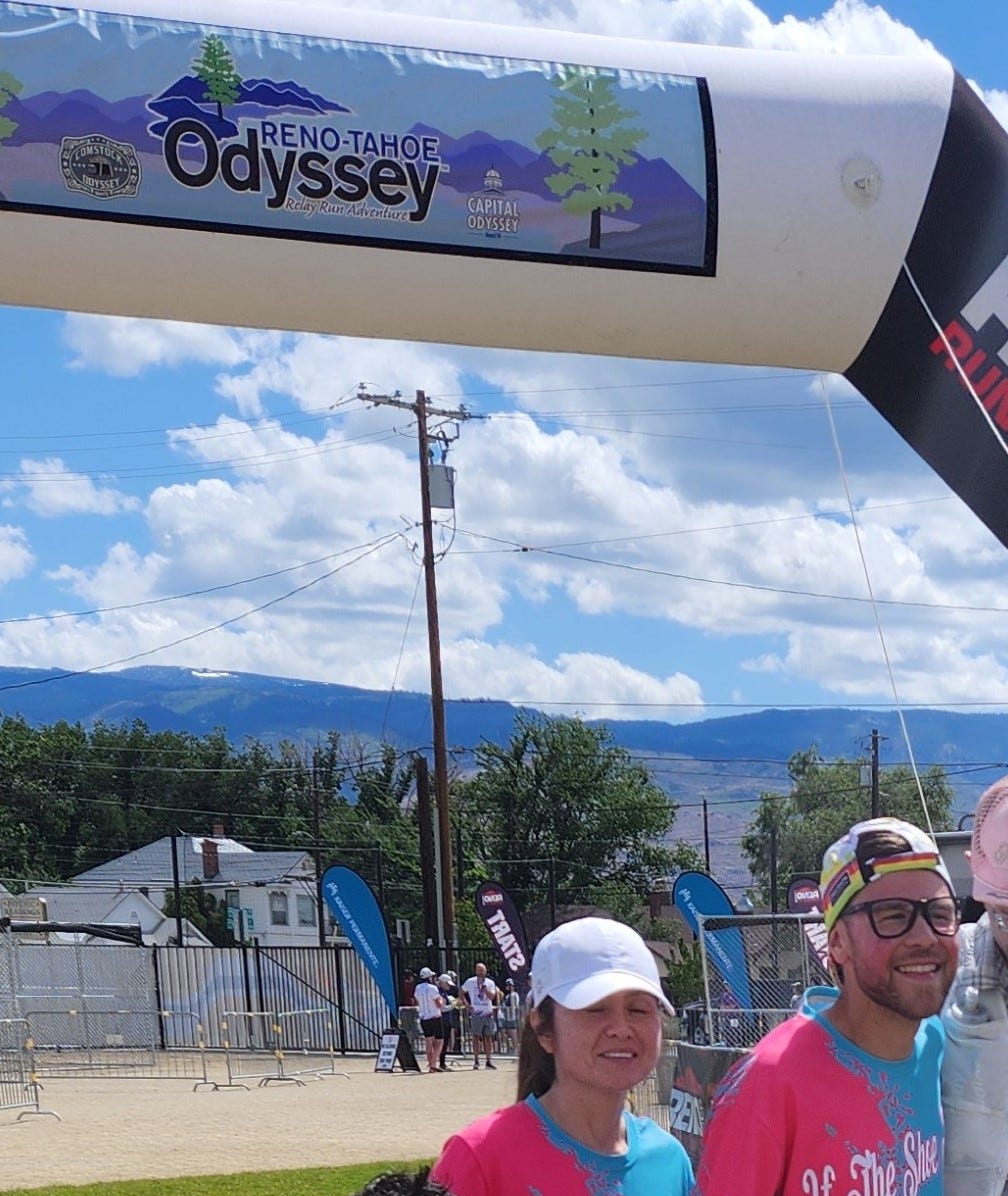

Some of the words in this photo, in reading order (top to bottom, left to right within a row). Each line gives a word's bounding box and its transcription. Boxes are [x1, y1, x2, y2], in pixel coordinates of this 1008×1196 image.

[261, 121, 440, 162] RENO-TAHOE
[75, 145, 123, 165] COMSTOCK
[164, 119, 439, 221] Odyssey
[82, 174, 120, 189] ODYSSEY
[285, 198, 318, 218] Relay
[318, 202, 344, 215] Run
[345, 204, 408, 221] Adventure
[468, 197, 519, 217] CAPITAL
[468, 215, 519, 232] ODYSSEY
